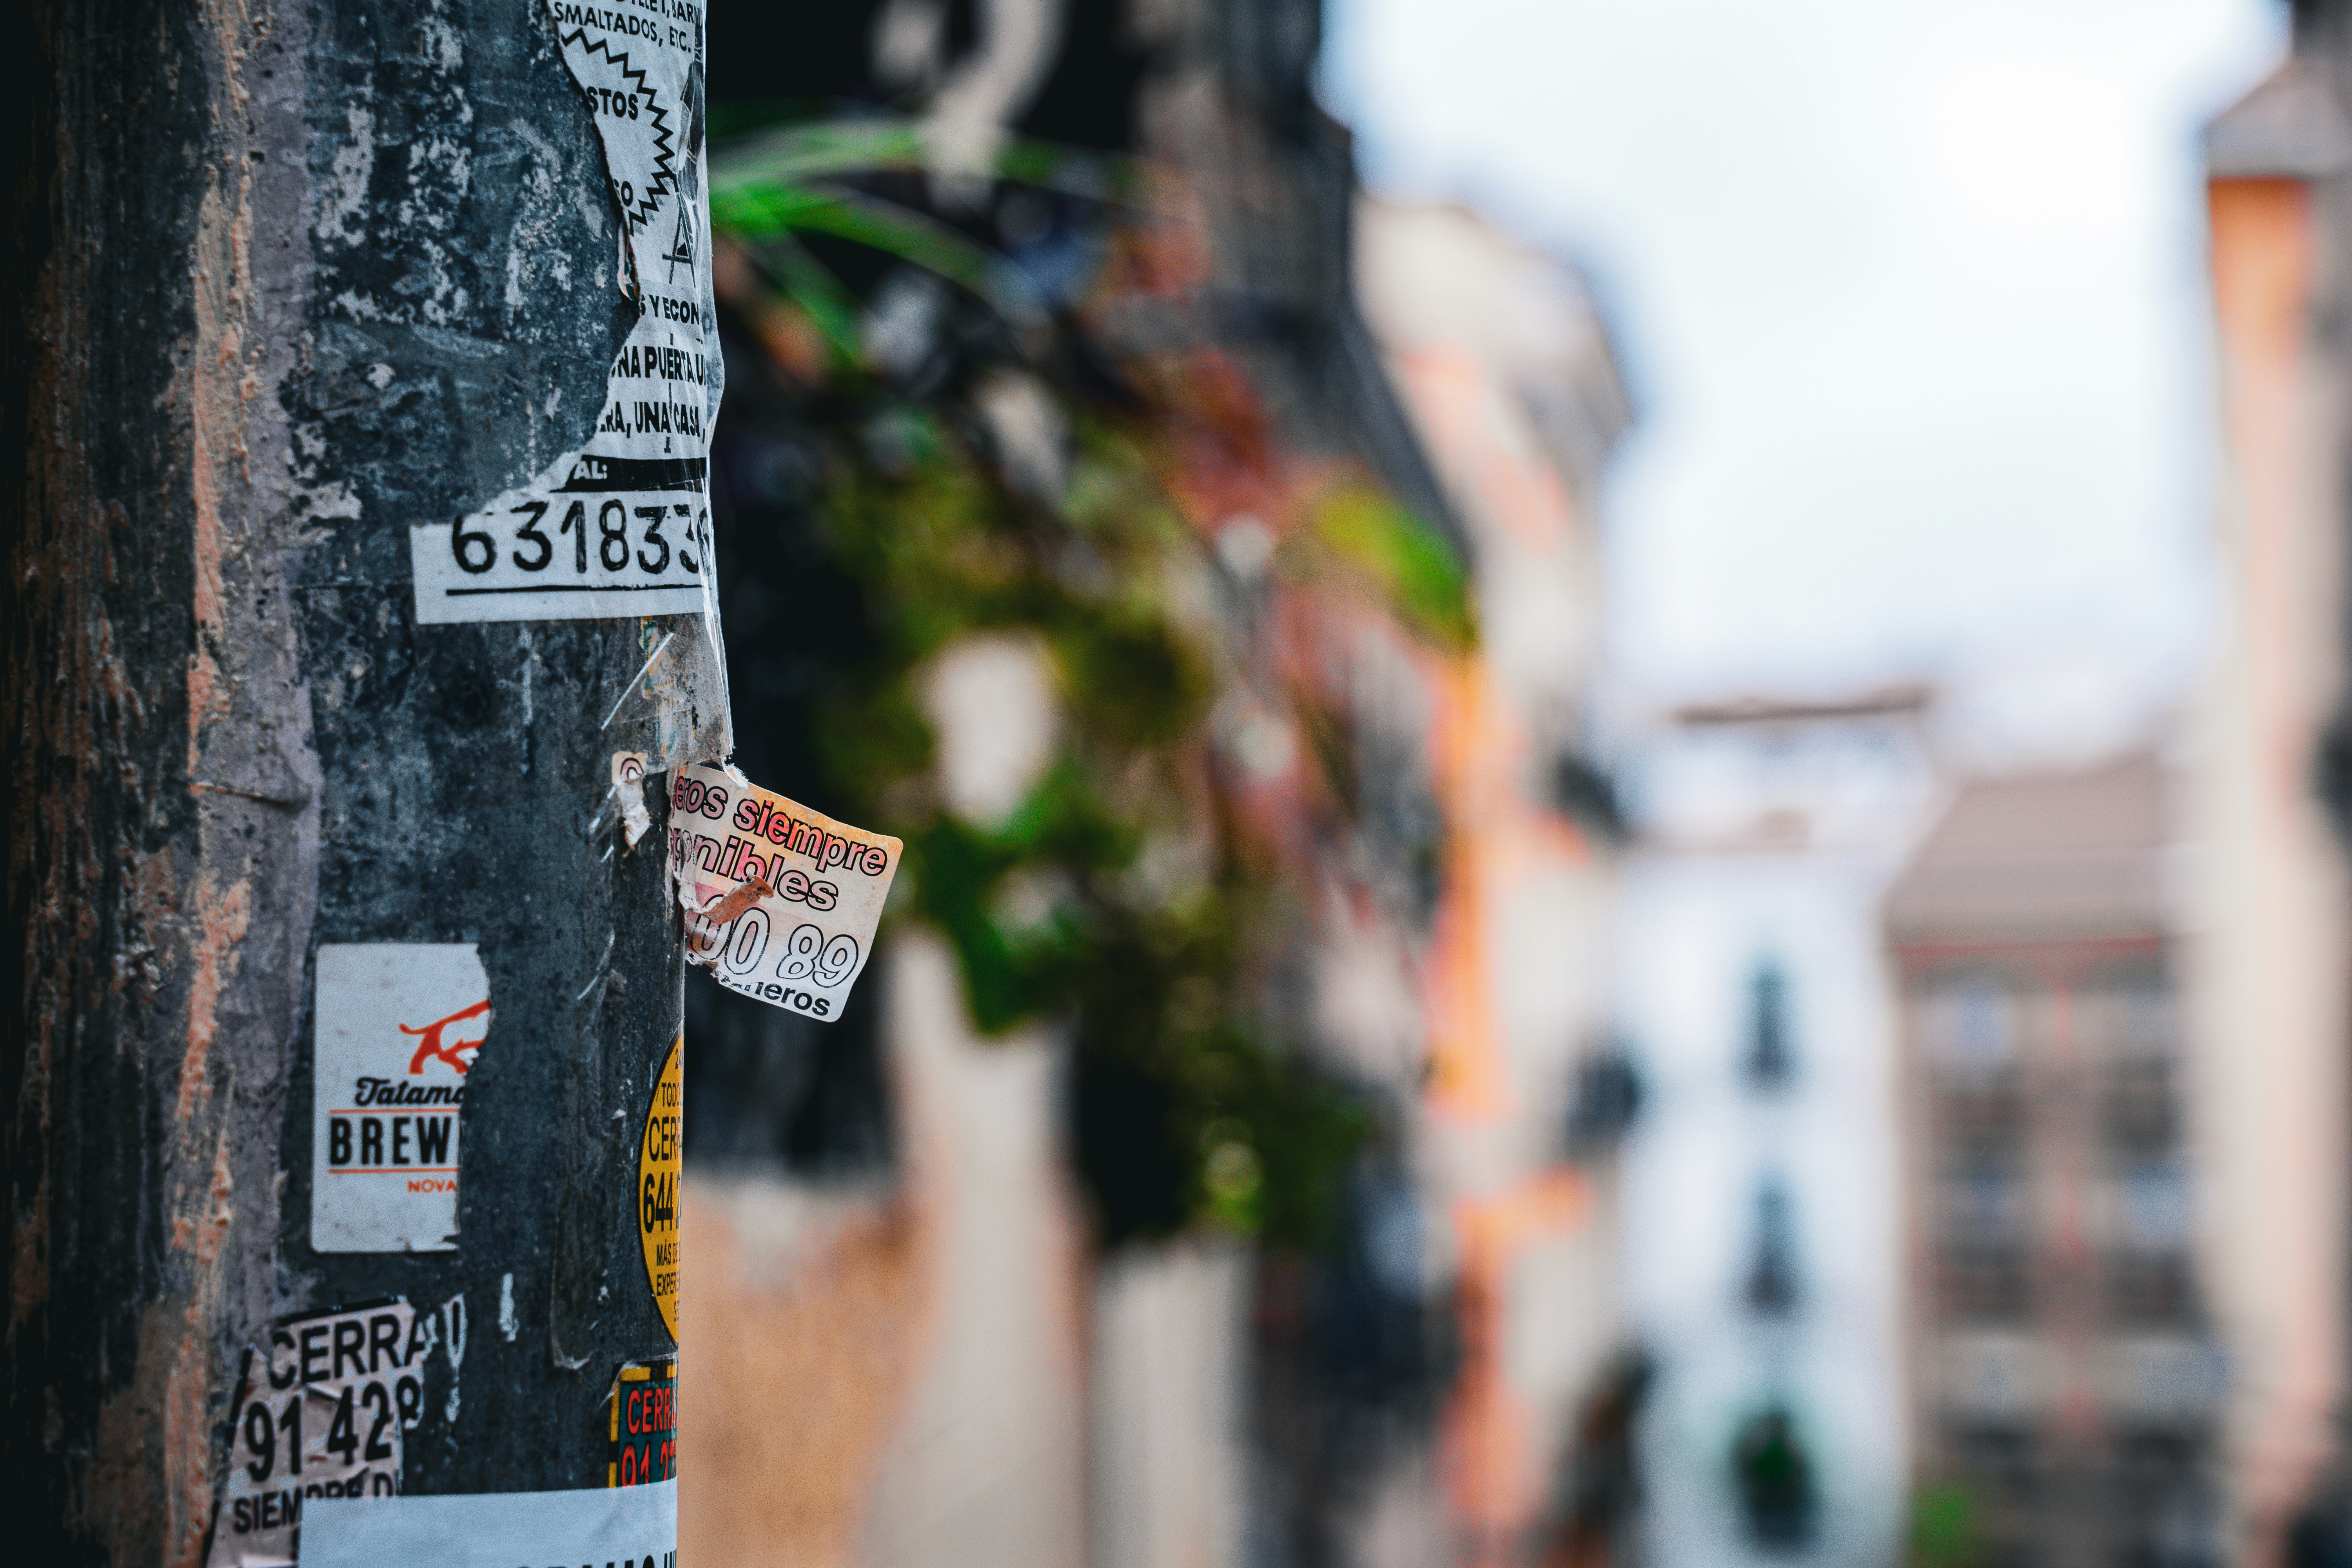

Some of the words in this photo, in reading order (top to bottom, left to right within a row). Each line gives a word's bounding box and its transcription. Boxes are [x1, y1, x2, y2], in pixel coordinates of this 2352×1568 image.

[554, 2, 663, 47] SMALTADOS,
[669, 25, 691, 53] ETC.
[649, 294, 659, 317] Y
[634, 401, 671, 433] UNA
[733, 798, 887, 877] siempre
[776, 923, 859, 988] 89
[330, 1117, 451, 1165] BREW
[408, 1179, 457, 1193] NOVA
[644, 1171, 673, 1233] 644
[657, 1238, 671, 1267] MÁS
[245, 1395, 302, 1482] 91
